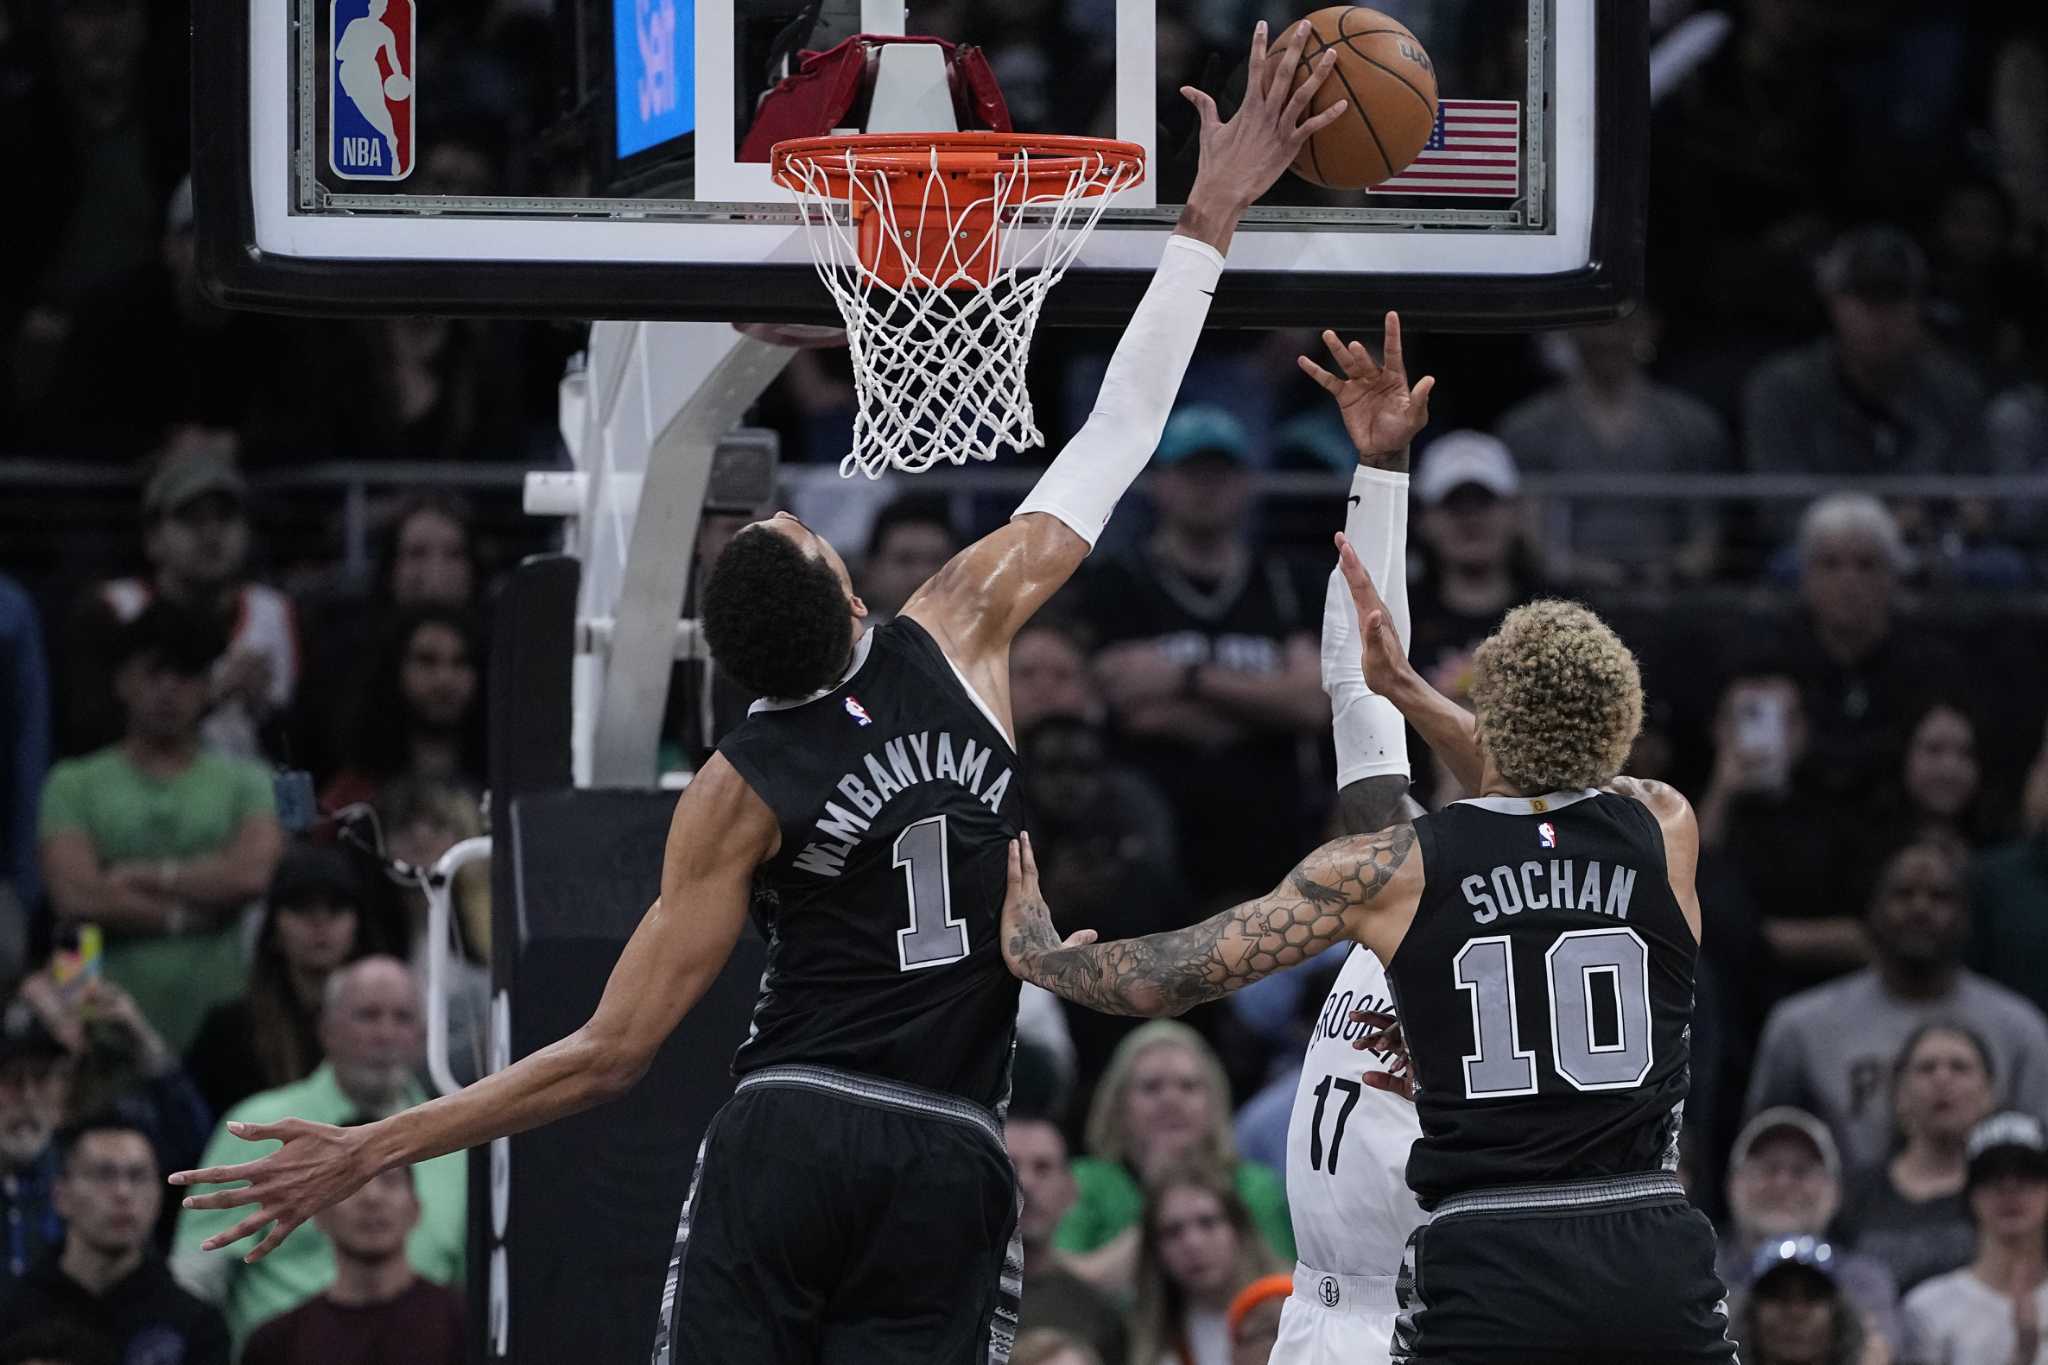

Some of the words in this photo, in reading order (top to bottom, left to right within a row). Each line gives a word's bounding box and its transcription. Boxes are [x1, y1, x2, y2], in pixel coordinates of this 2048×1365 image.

[343, 137, 382, 167] NBA
[893, 814, 970, 972] 1
[1461, 859, 1637, 924] SOCHAN
[1453, 927, 1653, 1099] 10
[1310, 1074, 1361, 1175] 17
